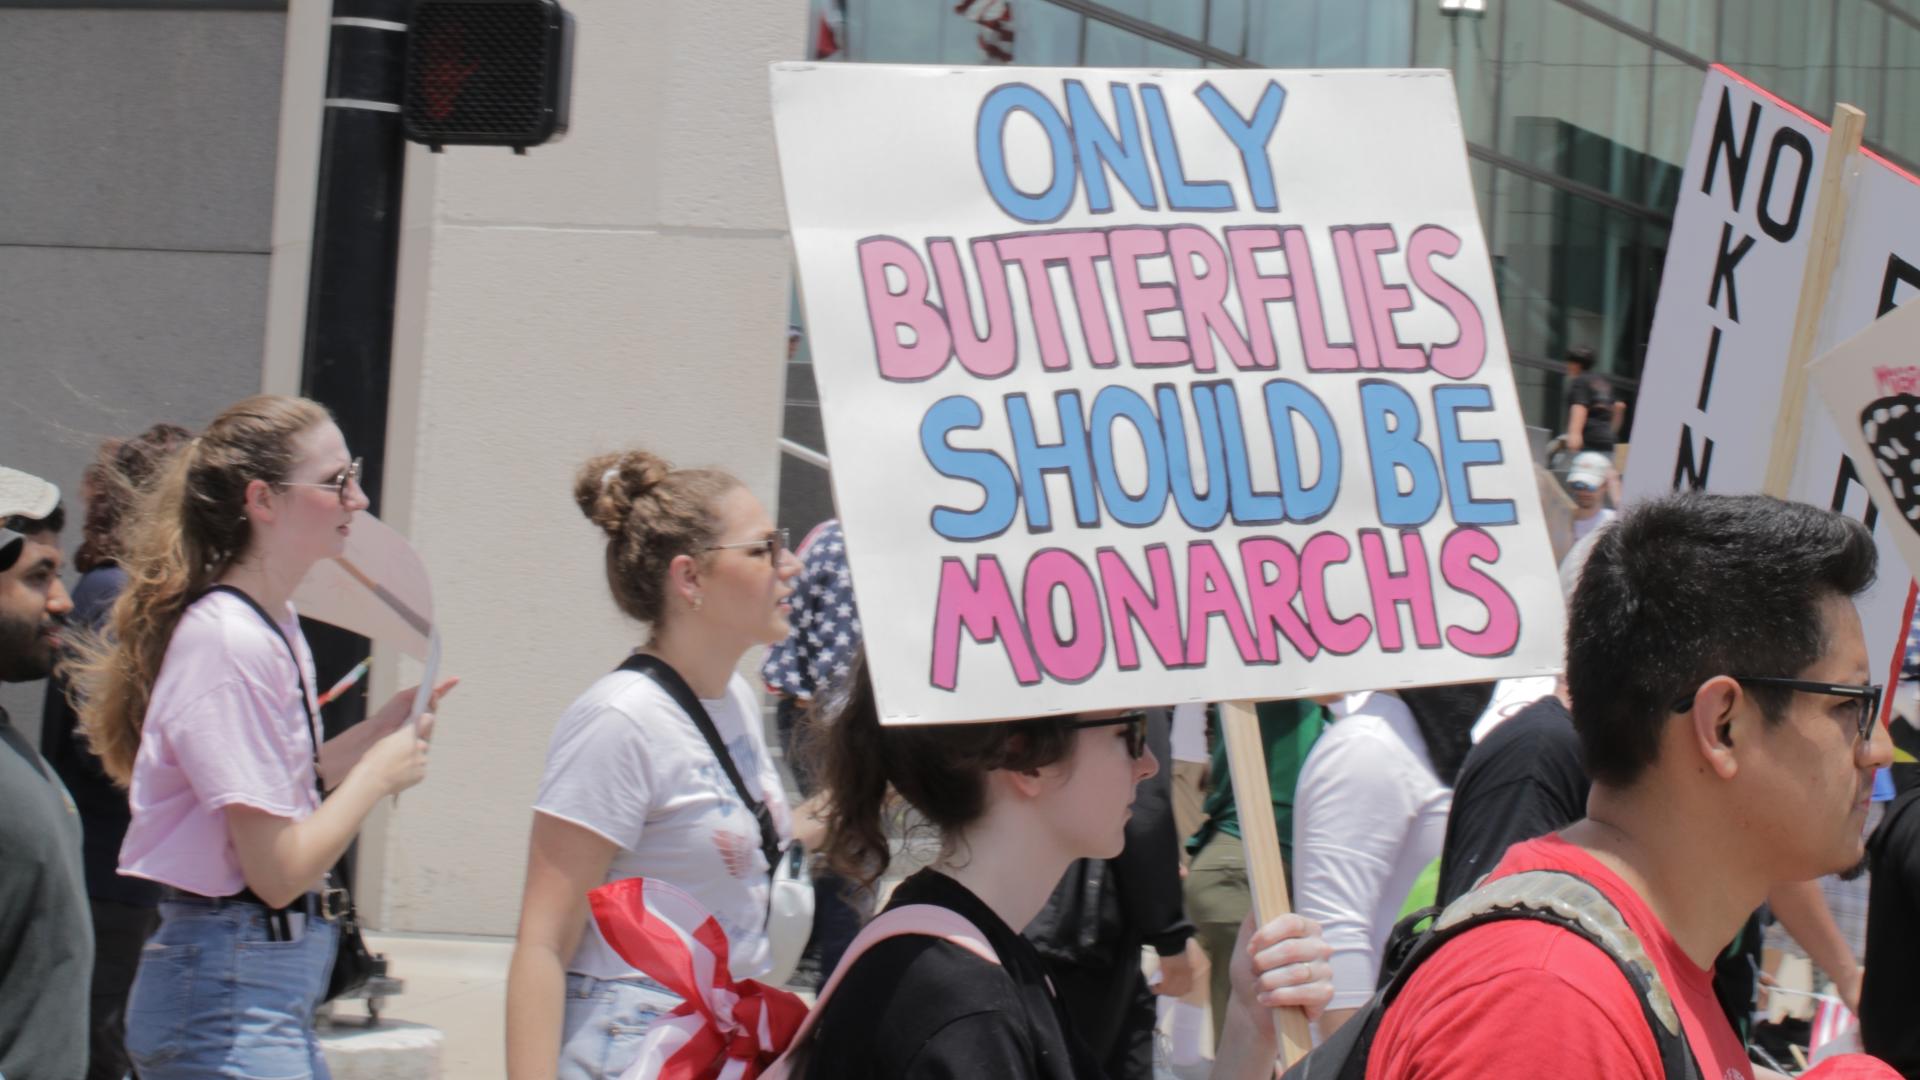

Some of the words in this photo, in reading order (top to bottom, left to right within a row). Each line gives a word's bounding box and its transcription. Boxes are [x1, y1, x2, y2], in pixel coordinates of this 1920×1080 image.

[976, 78, 1287, 223] ONLY
[1702, 85, 1812, 242] NO
[856, 222, 1487, 382] BUTTERFLIES
[919, 379, 1343, 542] SHOULD
[1359, 379, 1518, 529] BE
[930, 526, 1521, 691] MONARCHS
